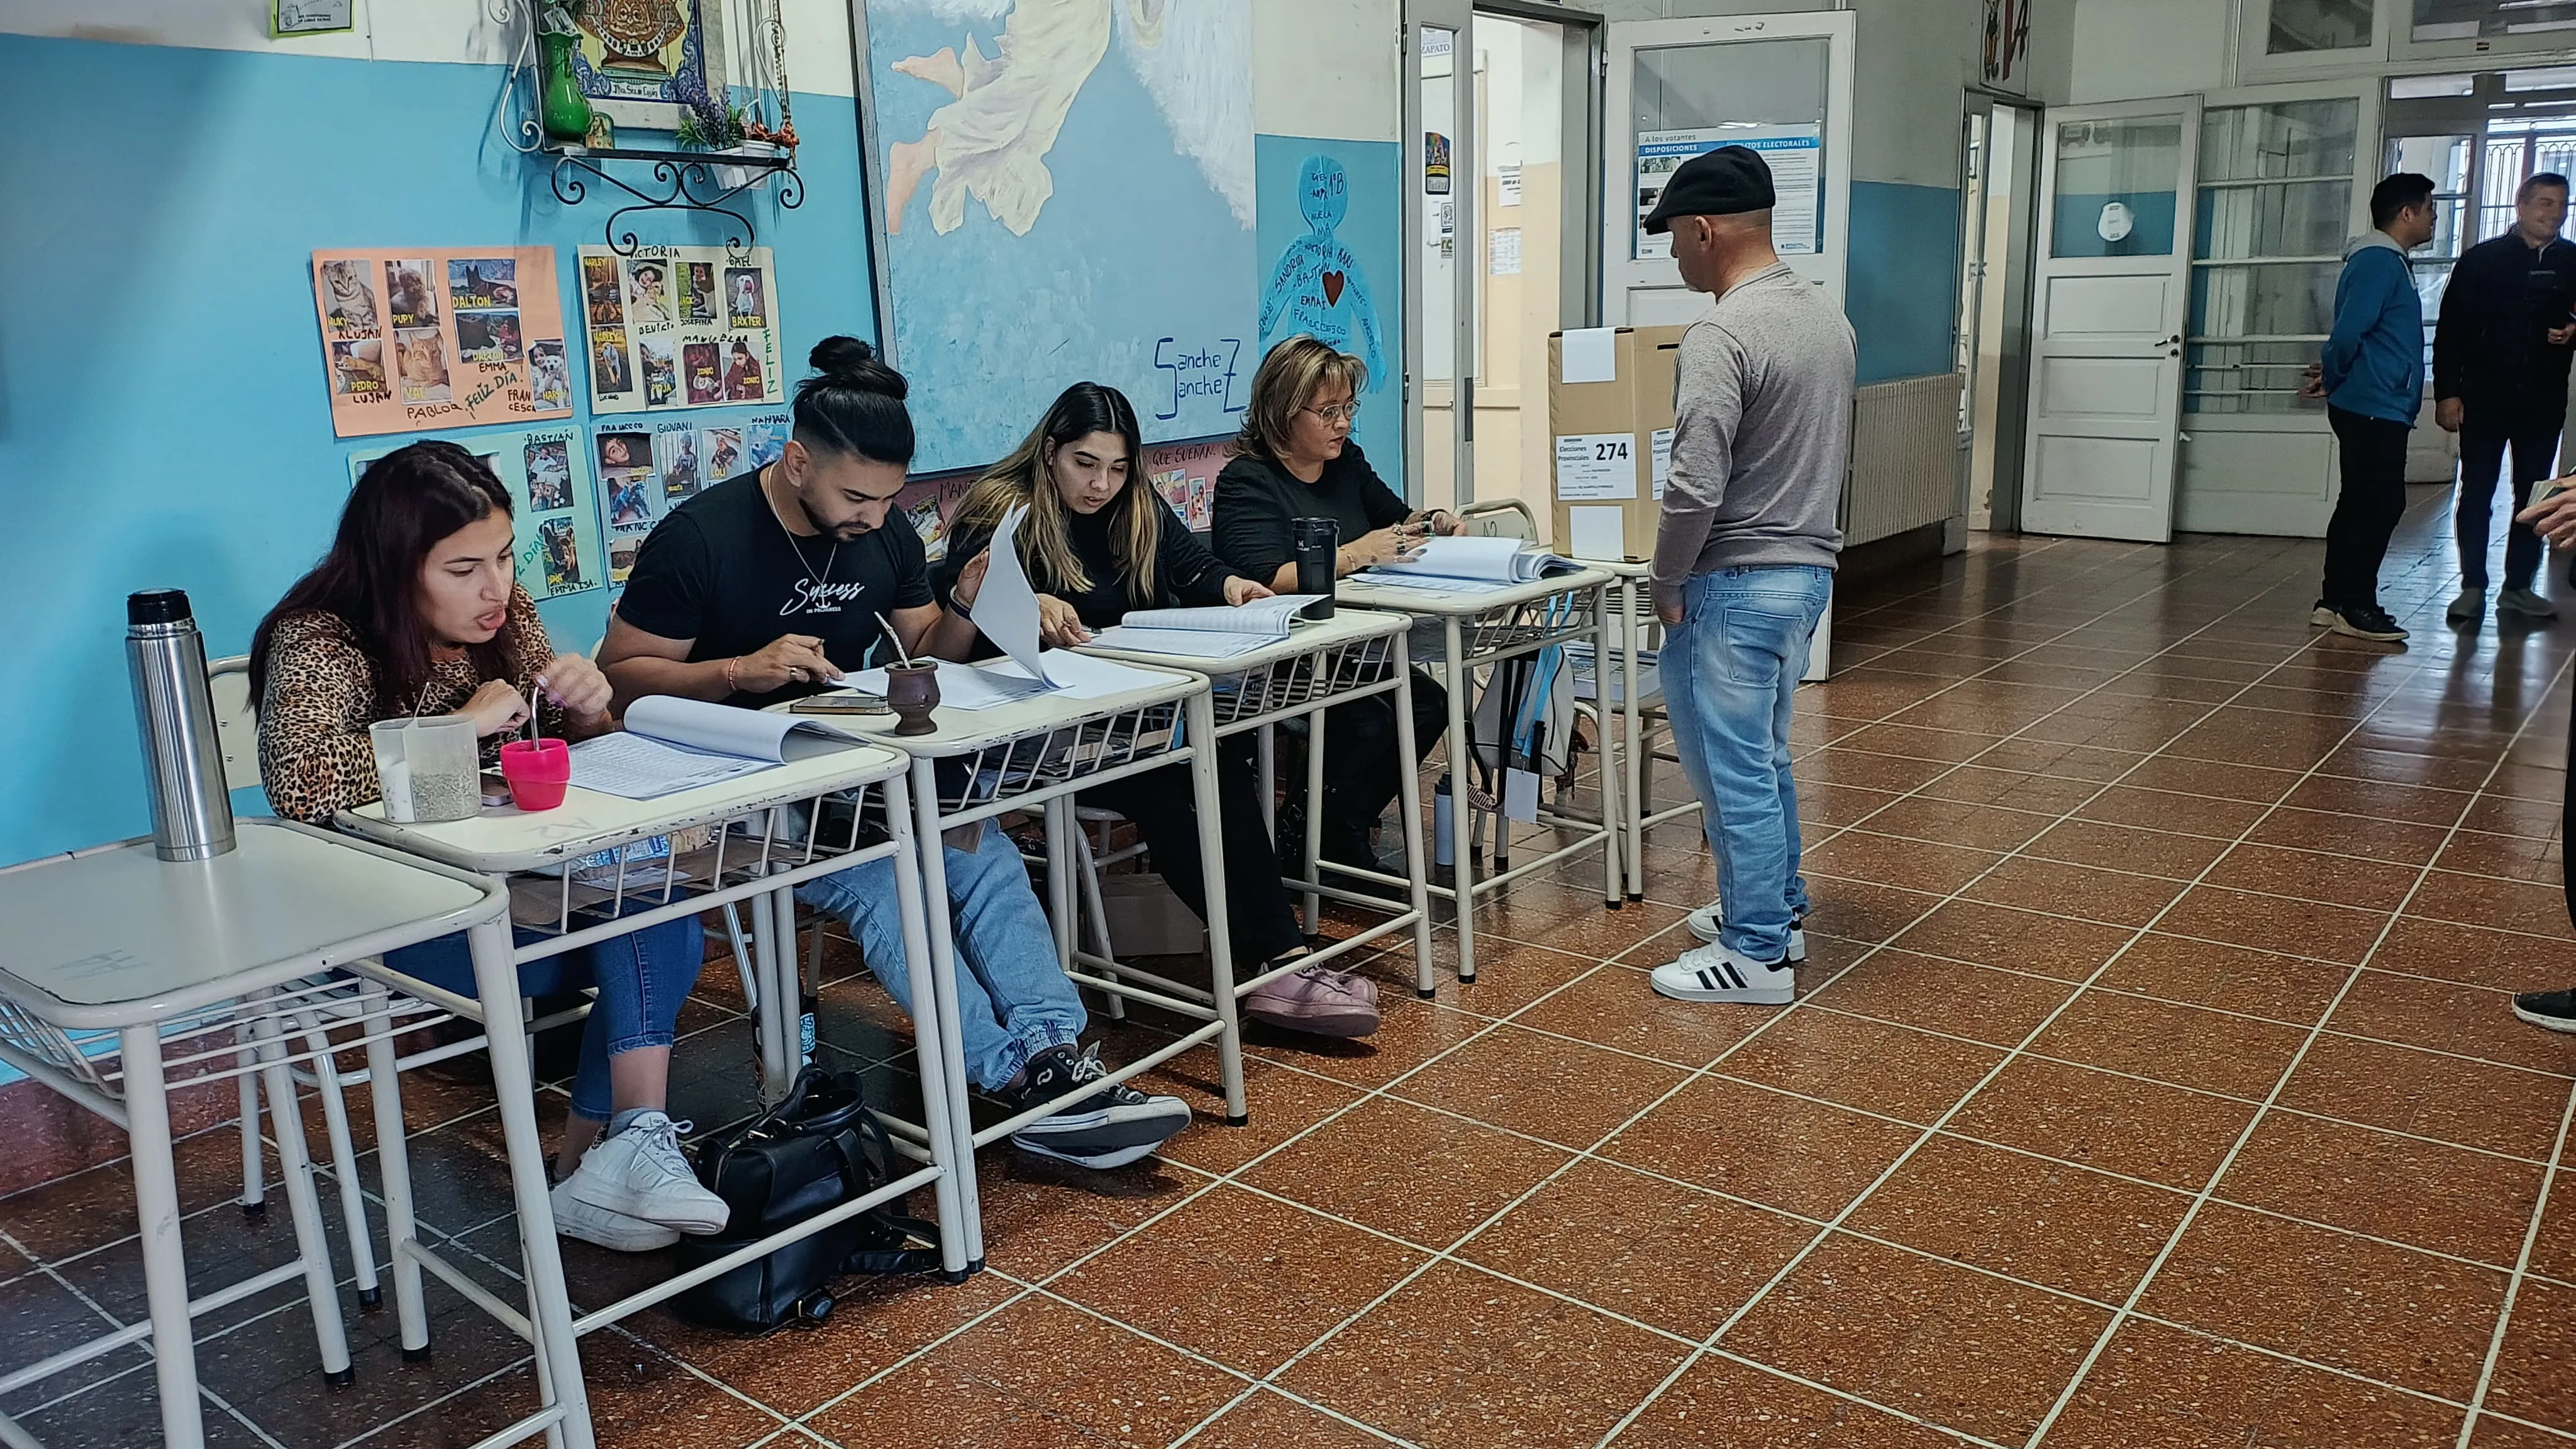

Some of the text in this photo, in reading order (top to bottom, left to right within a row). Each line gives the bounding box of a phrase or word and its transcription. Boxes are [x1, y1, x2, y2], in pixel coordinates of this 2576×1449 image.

[1645, 145, 1698, 153] DISPOSICIONES
[1763, 140, 1810, 148] ELECTORALES
[453, 295, 491, 308] DALTON
[392, 314, 414, 324] PUPY
[732, 316, 762, 326] BAXTER
[479, 362, 507, 372] EMMA
[351, 380, 379, 391] PEDRO
[657, 421, 692, 433] GIOVANI
[1596, 442, 1628, 460] 274
[1153, 448, 1171, 467] QUE
